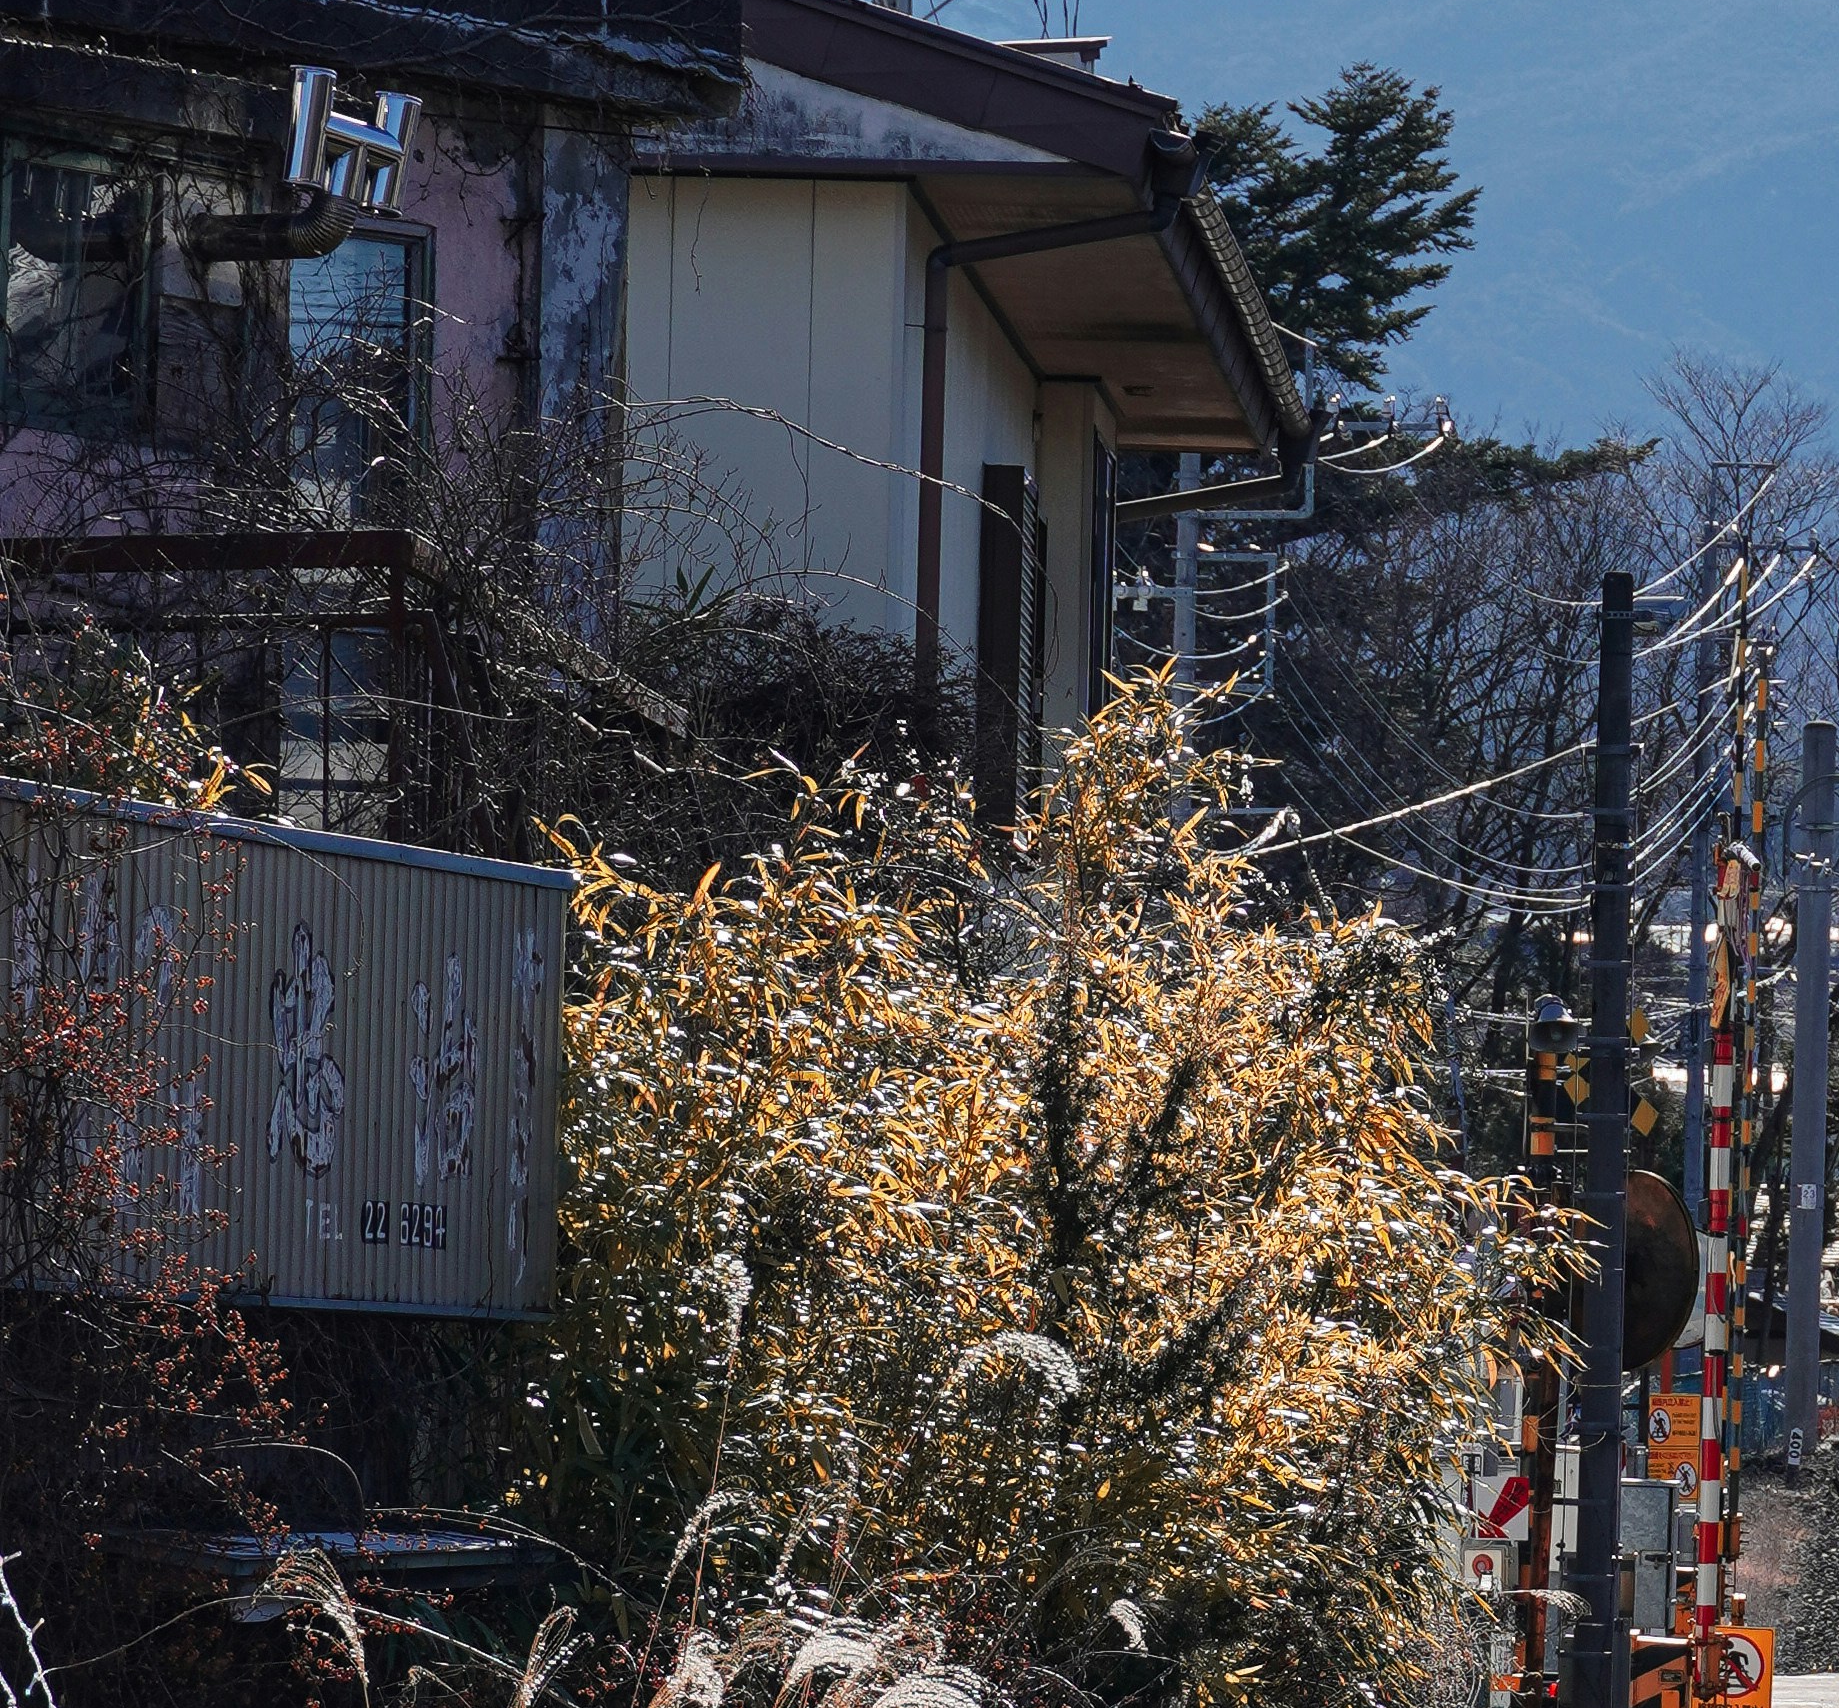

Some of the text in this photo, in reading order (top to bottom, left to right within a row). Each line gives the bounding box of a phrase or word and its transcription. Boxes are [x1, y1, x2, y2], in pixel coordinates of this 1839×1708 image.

[1803, 1189, 1815, 1199] 23
[305, 1198, 343, 1240] TEL
[365, 1200, 386, 1240] 22
[1789, 1429, 1803, 1460] 400
